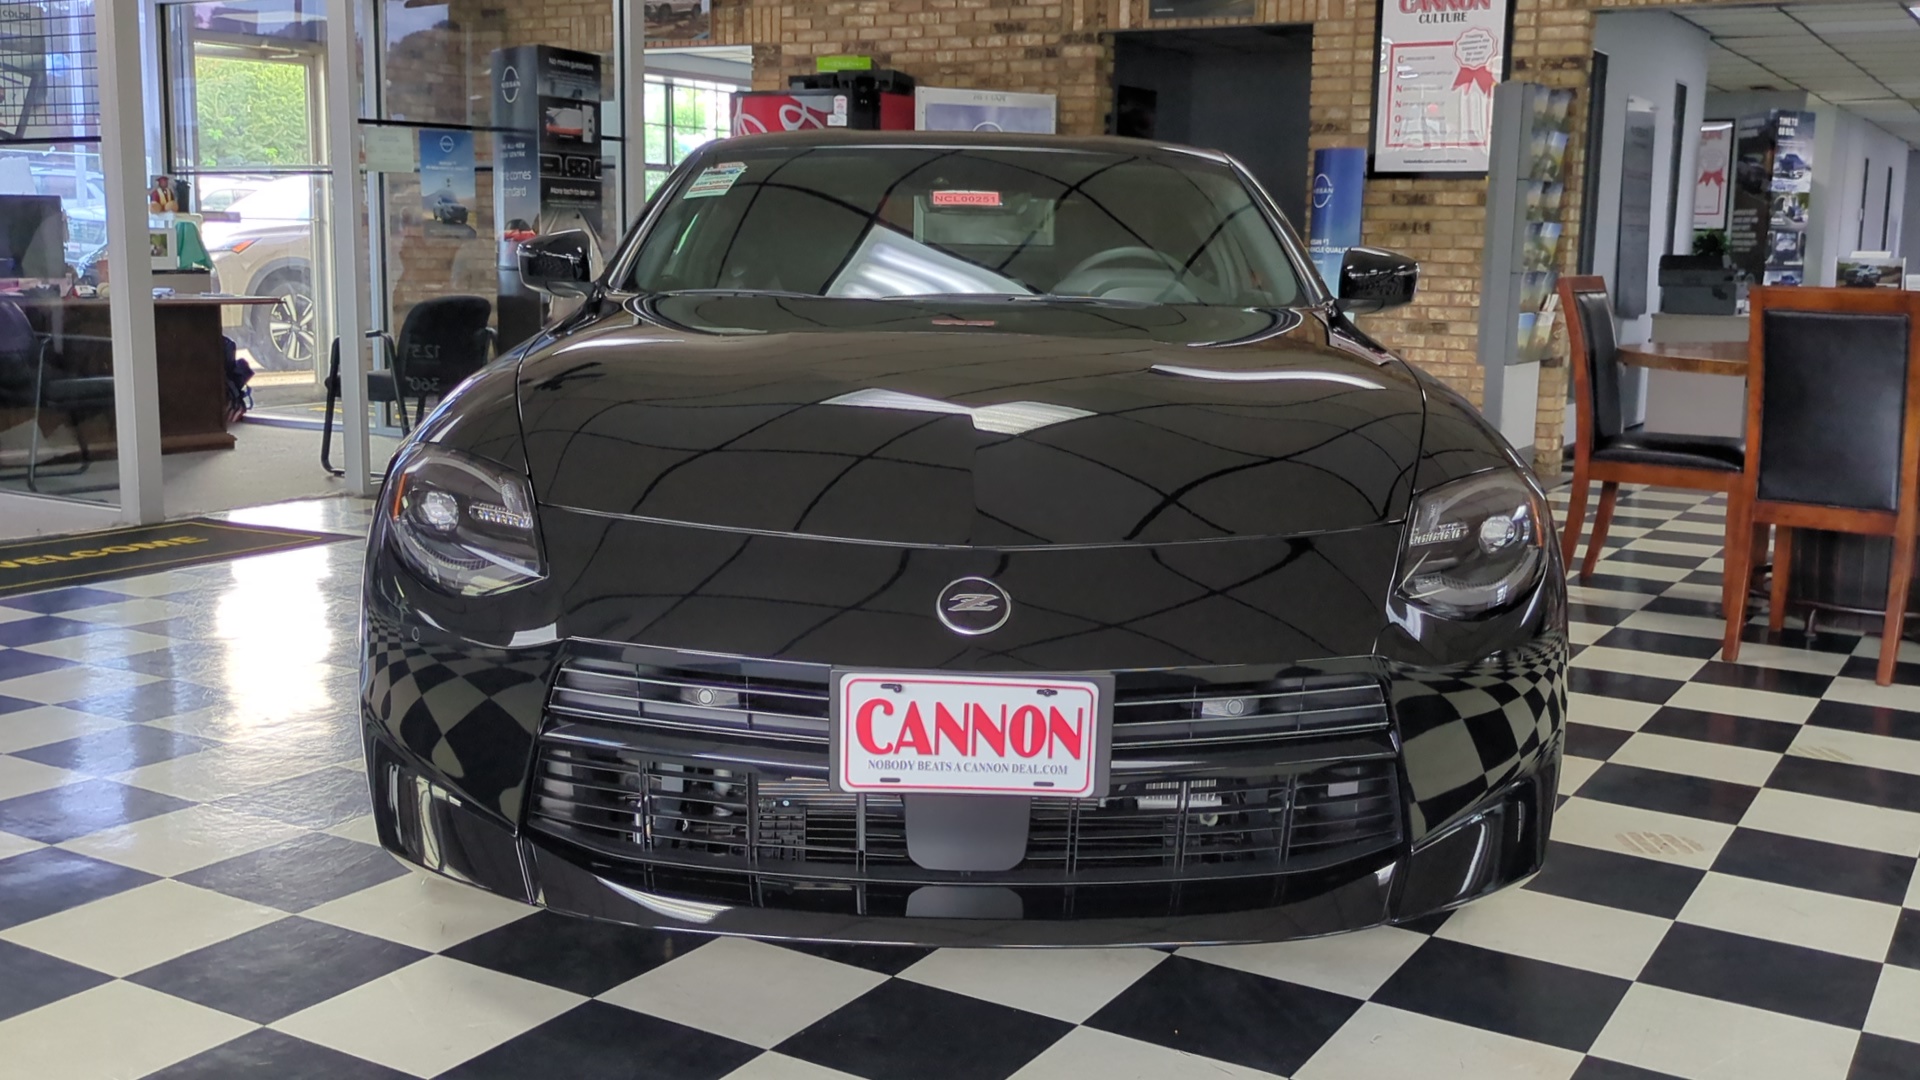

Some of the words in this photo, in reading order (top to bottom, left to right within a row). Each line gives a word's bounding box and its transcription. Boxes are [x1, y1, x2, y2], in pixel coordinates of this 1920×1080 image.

[1418, 12, 1468, 24] CULTURE
[509, 170, 532, 181] comes
[935, 195, 996, 203] NCL00251
[855, 698, 1083, 760] CANNON
[867, 759, 916, 771] NOBODY
[917, 761, 951, 772] BEATS
[953, 762, 962, 773] A
[963, 763, 1009, 774] CANNON
[1011, 764, 1068, 775] DEAL.COM
